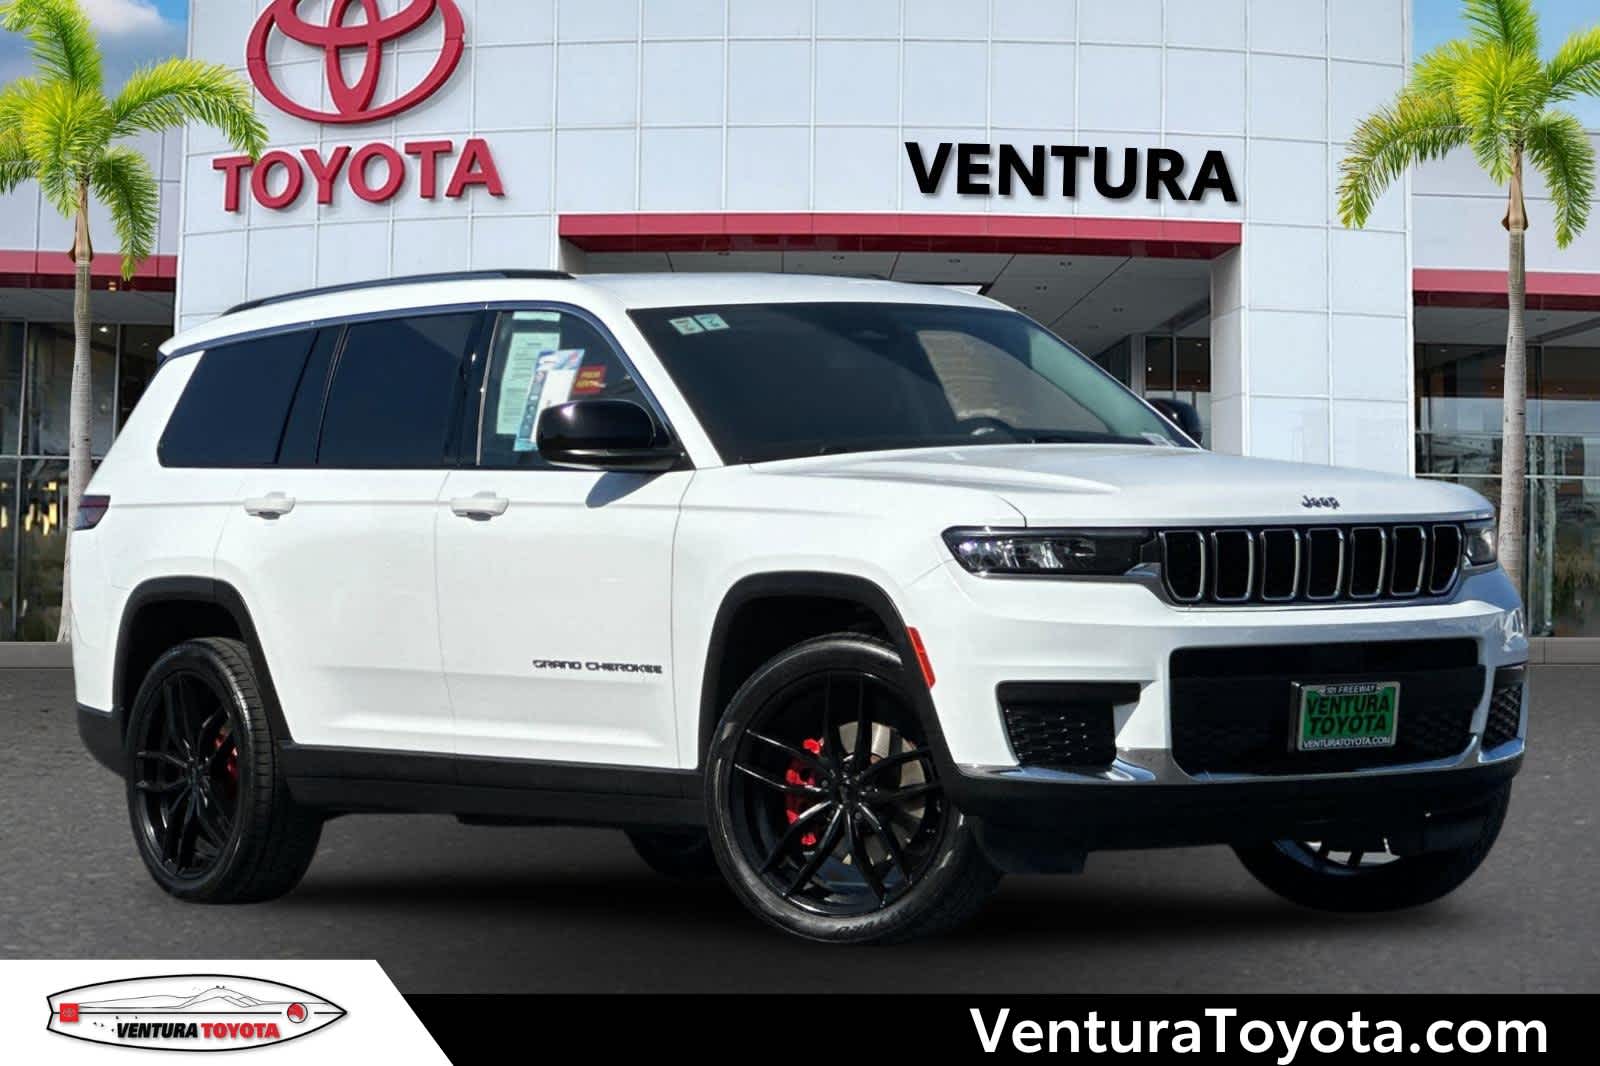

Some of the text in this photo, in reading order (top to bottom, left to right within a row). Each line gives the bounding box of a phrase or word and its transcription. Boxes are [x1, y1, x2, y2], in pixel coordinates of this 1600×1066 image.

[213, 139, 505, 211] TOYOTA
[904, 142, 1238, 202] VENTURA
[1302, 495, 1340, 509] Jeep
[533, 660, 662, 674] GRAND CHEROKEE
[1338, 684, 1376, 693] FREEWAY
[1306, 695, 1389, 714] VENTURA
[1310, 714, 1386, 735] TOYOTA
[1303, 737, 1391, 748] VENTURATOYOTA.COM
